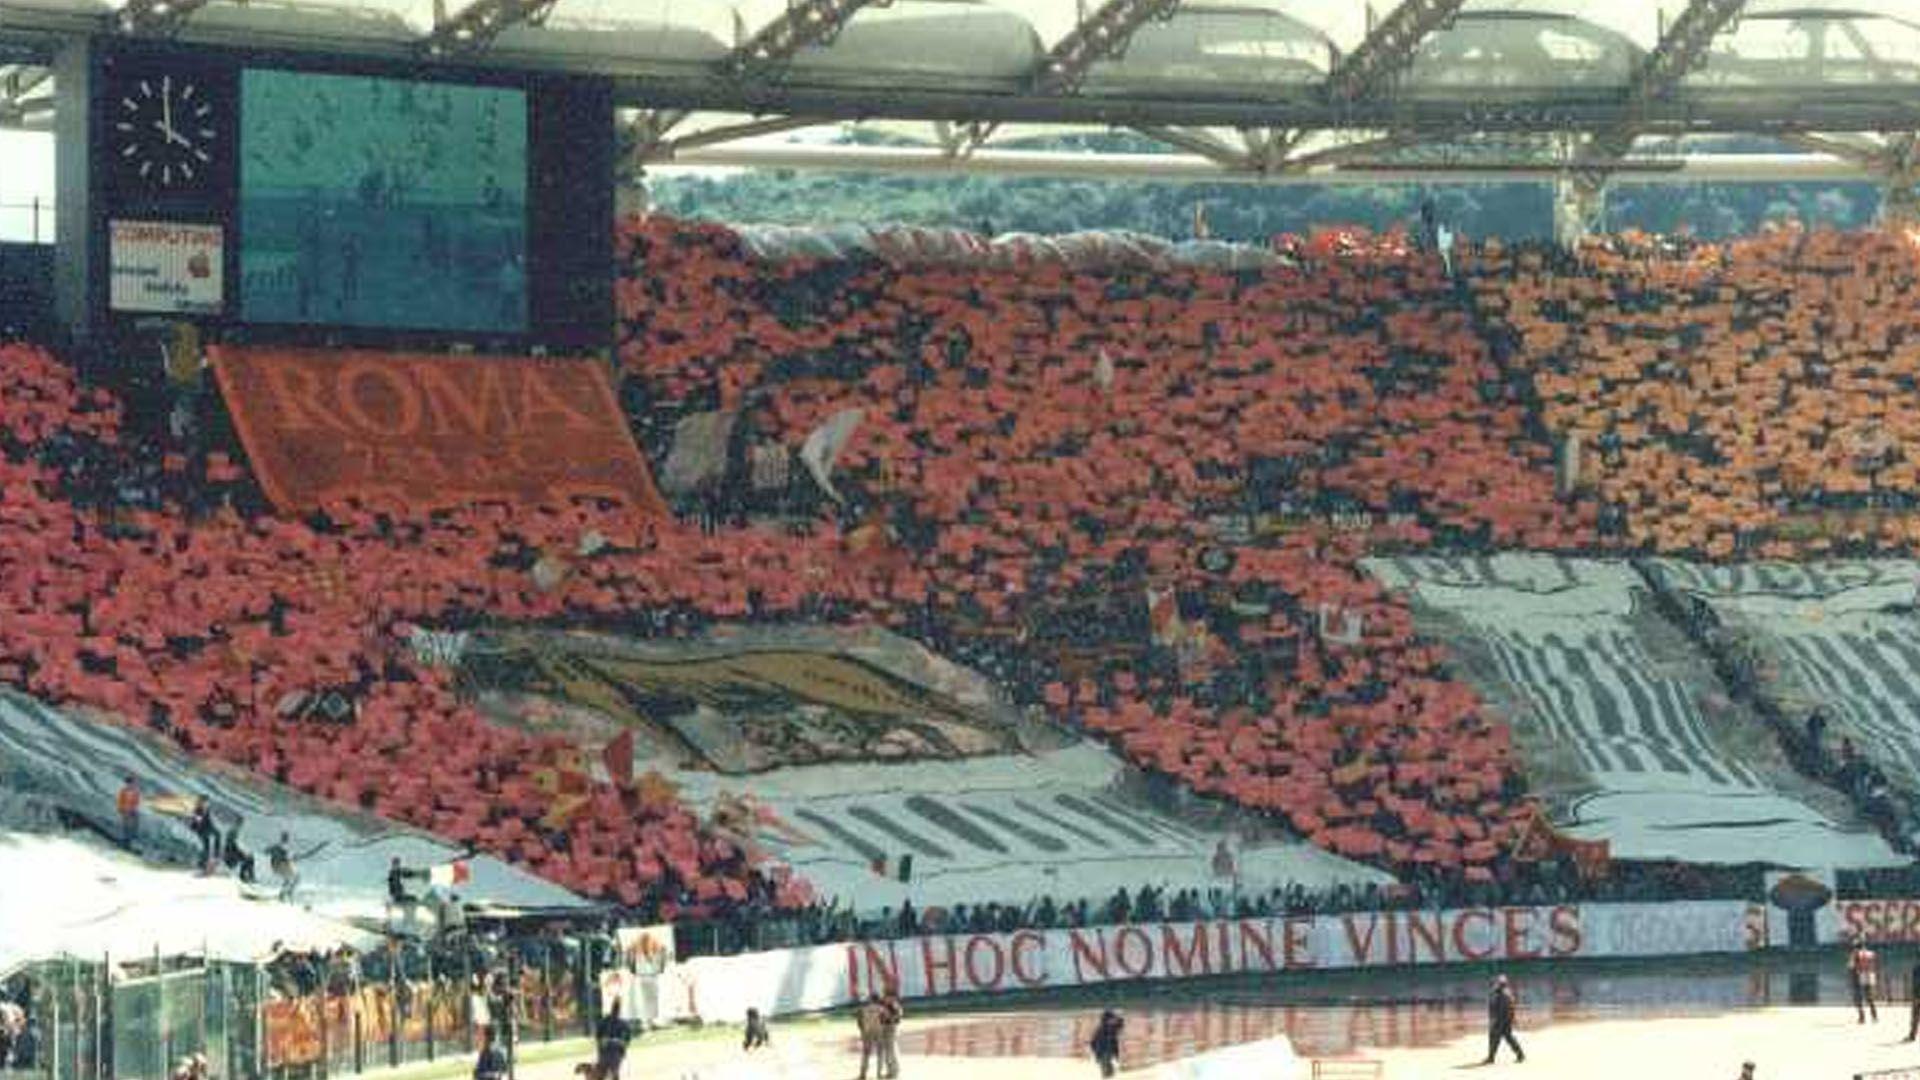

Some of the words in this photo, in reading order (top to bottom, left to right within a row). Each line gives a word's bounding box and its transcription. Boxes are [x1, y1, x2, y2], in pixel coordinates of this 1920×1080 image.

[266, 362, 598, 435] ROMA
[848, 942, 898, 1000] IN
[922, 930, 1048, 997] HOC
[1068, 918, 1320, 984] NOMINE
[1343, 904, 1582, 968] VINCES
